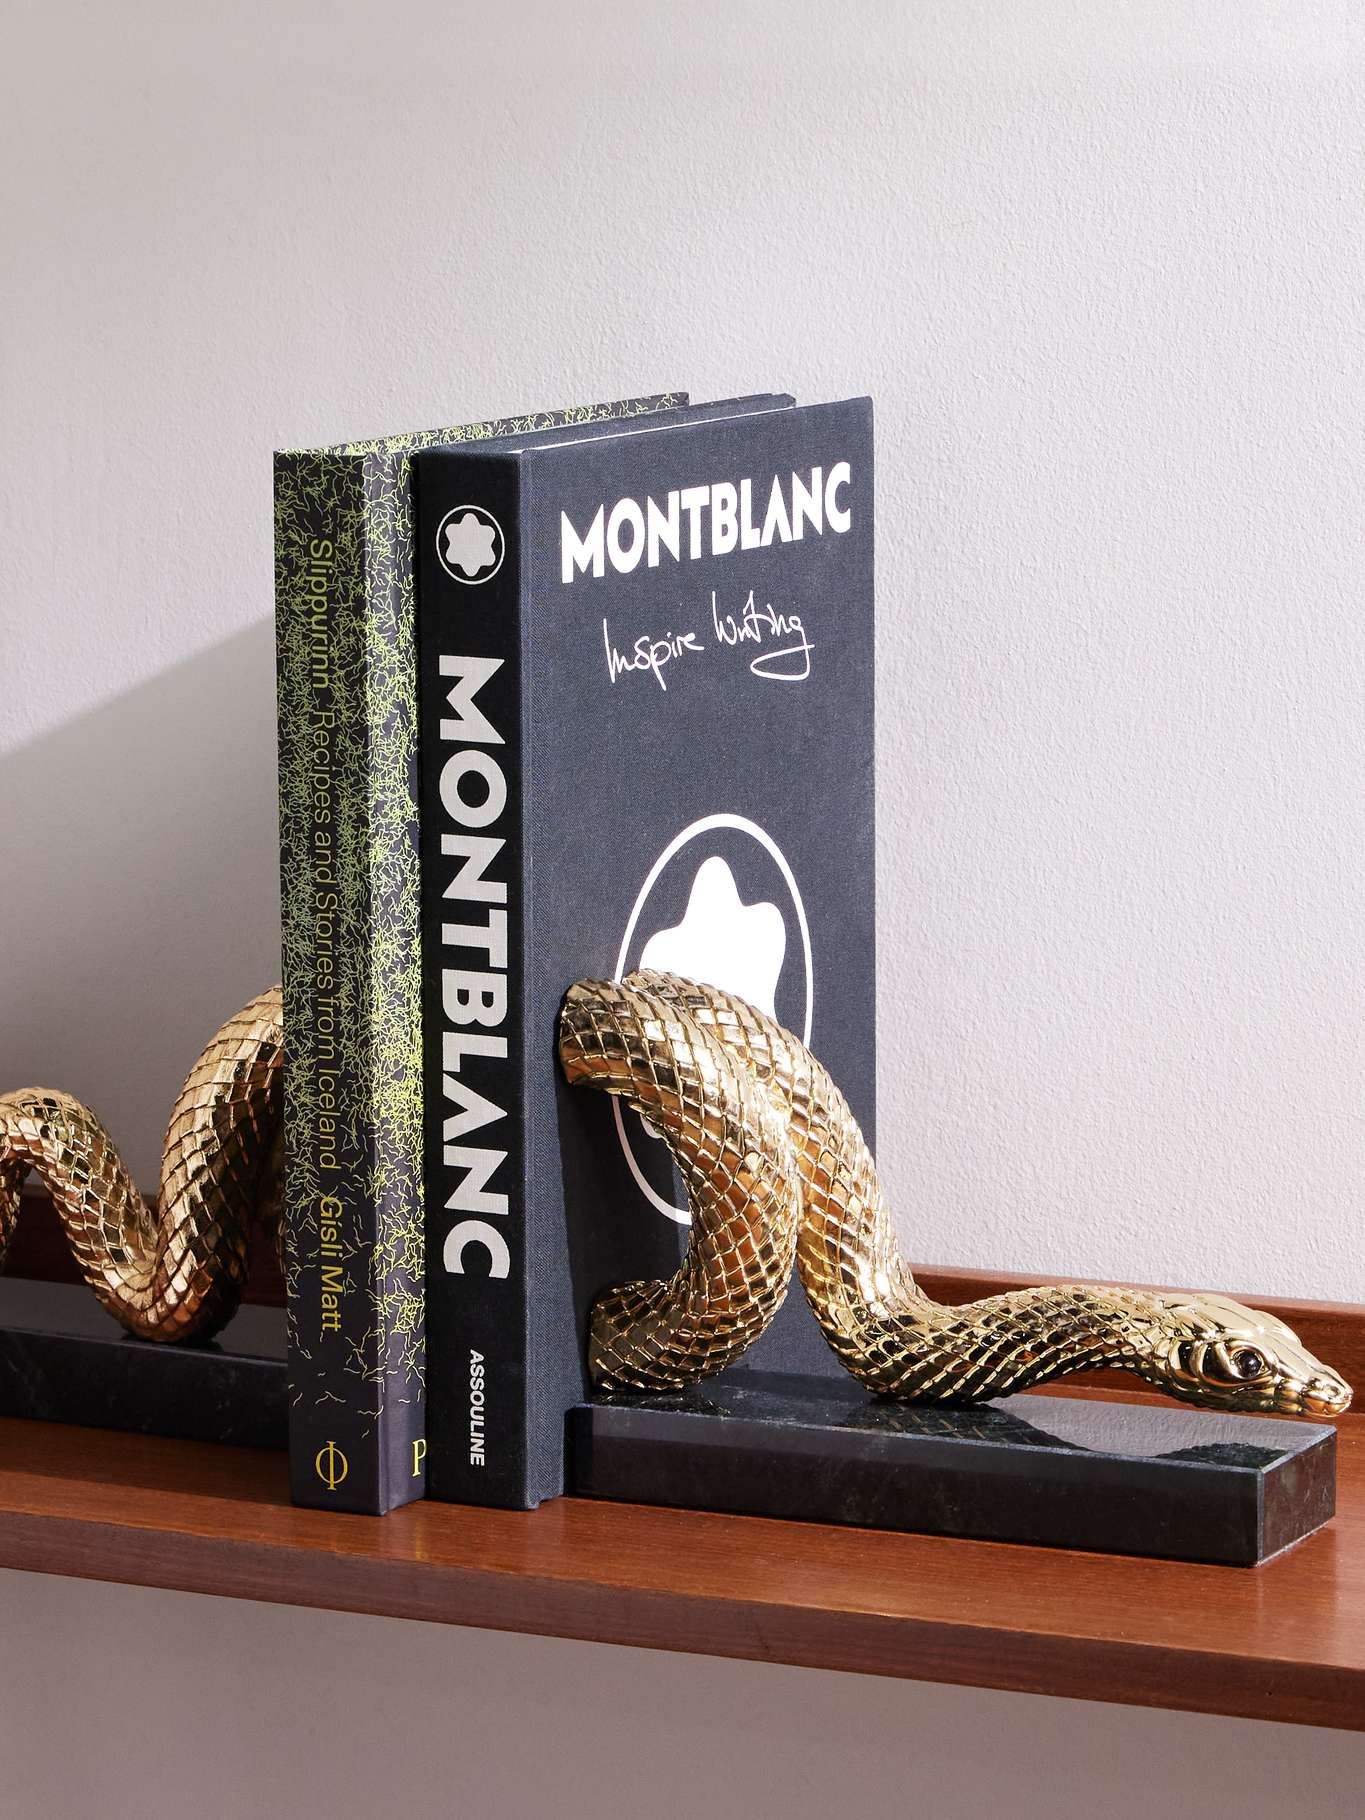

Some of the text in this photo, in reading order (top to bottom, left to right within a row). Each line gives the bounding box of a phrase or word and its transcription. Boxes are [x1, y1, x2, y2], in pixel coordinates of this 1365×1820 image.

[561, 461, 851, 584] MONTBLANC
[603, 590, 815, 691] Inspire Writing
[305, 538, 343, 1332] Slippurinn Recipes and Stories from Iceland Gísli Matt
[438, 654, 511, 1279] MONTBLANC
[469, 1349, 485, 1467] ASSOULINE
